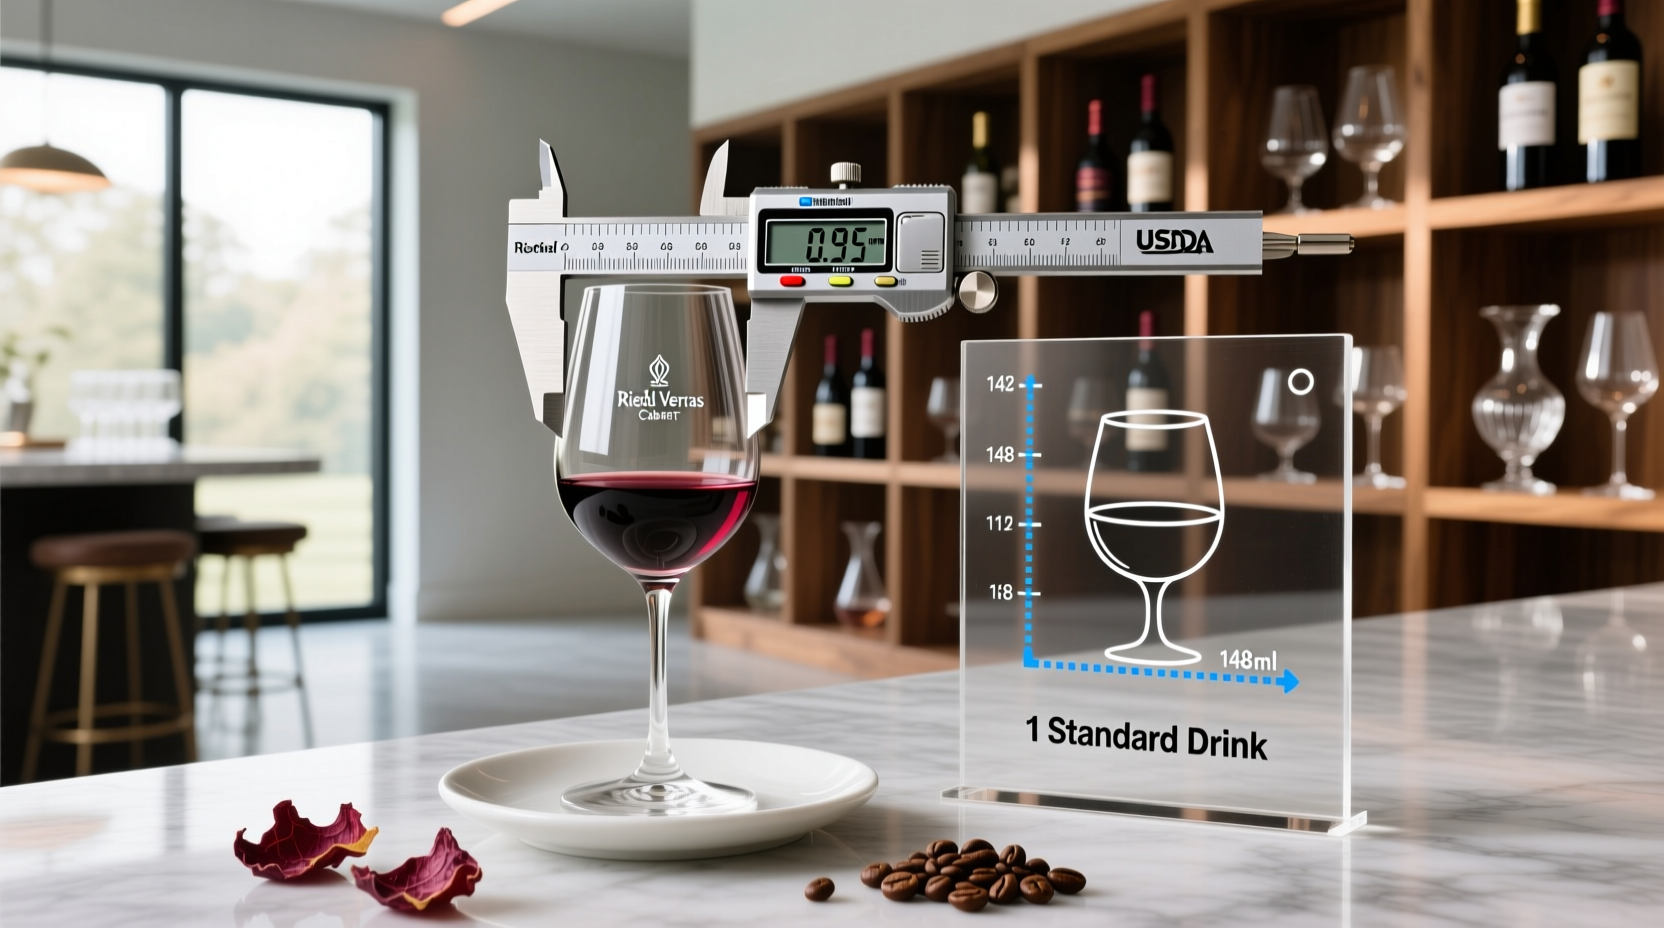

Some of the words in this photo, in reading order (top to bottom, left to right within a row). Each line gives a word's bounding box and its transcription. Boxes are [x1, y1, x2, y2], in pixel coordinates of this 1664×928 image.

[806, 227, 867, 263] 0.95
[986, 375, 1015, 392] 142
[986, 445, 1015, 463] 148
[986, 515, 1014, 531] 112
[1219, 649, 1278, 671] 148ml
[1026, 715, 1038, 742] 1
[1048, 716, 1178, 753] Standard
[1187, 726, 1268, 761] Drink
